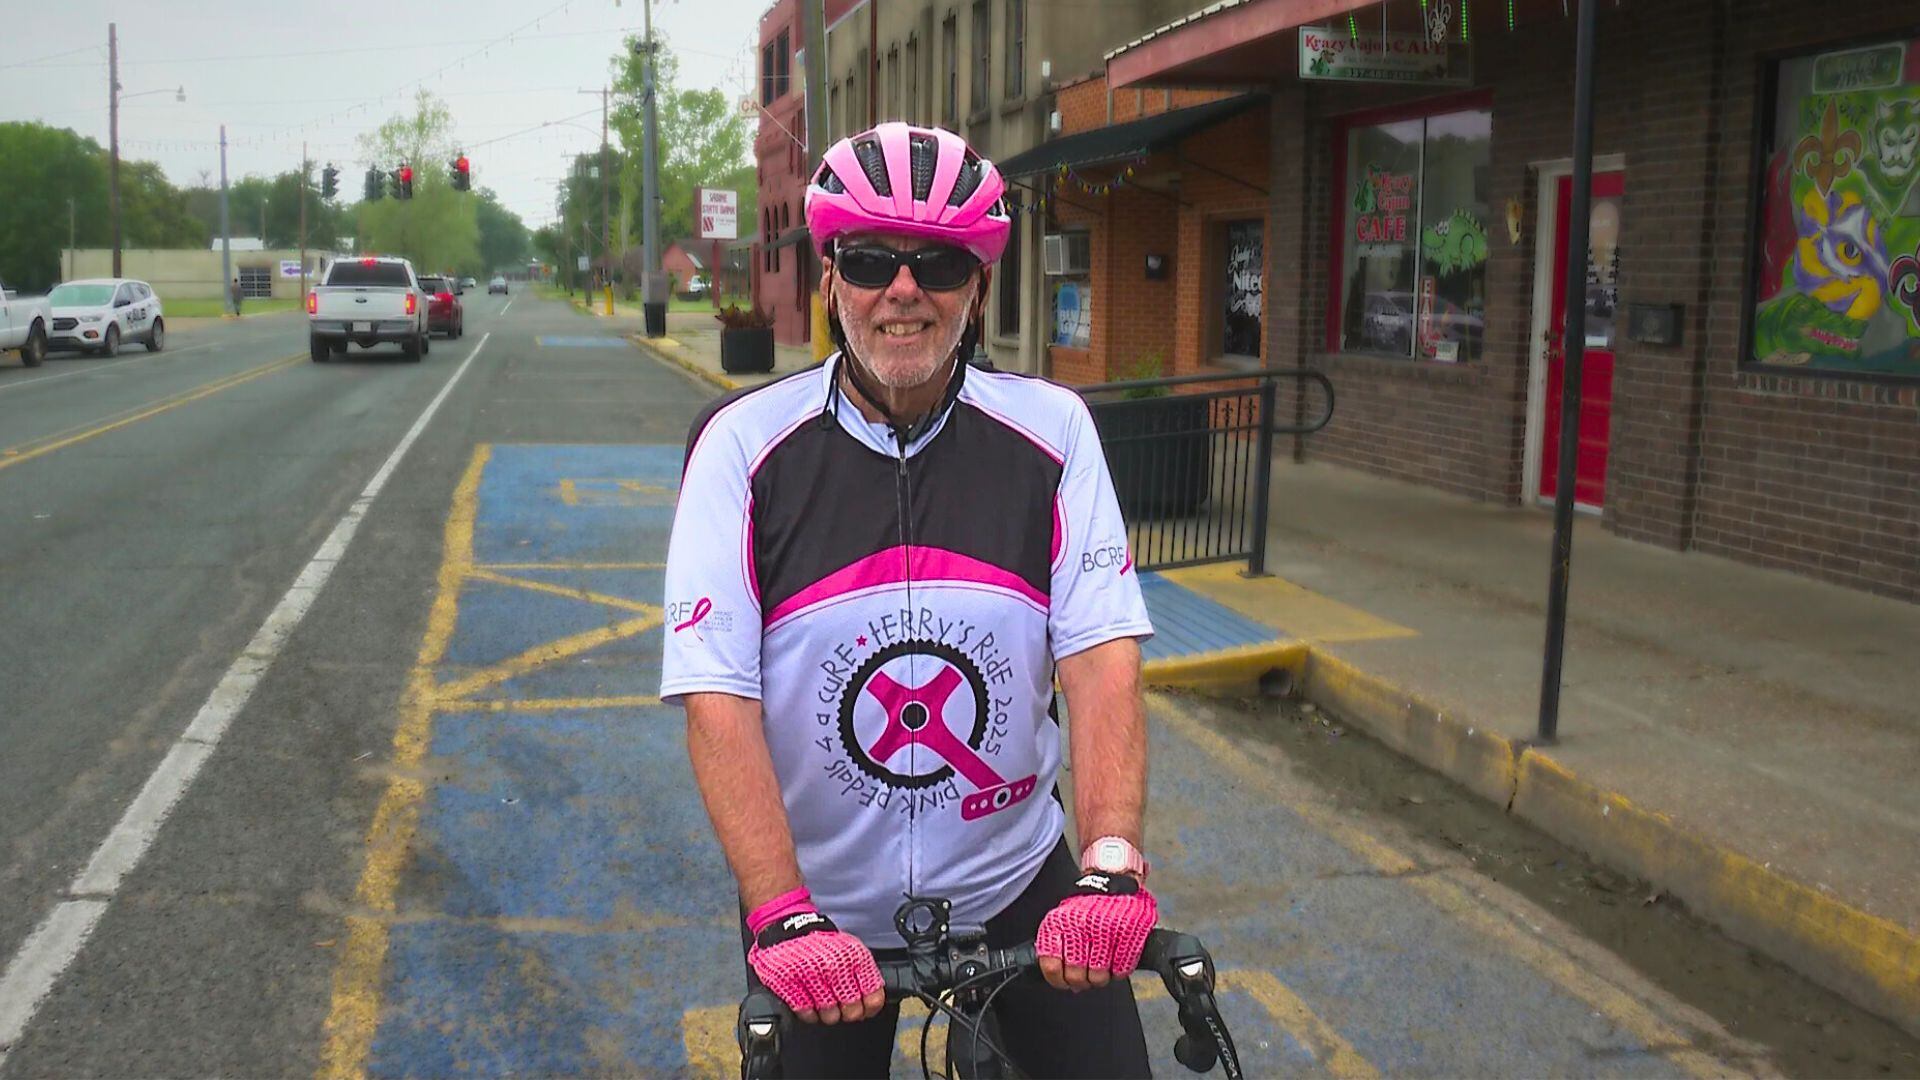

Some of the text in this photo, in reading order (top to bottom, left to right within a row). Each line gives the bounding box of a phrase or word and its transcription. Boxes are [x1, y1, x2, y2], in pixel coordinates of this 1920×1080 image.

[1304, 34, 1346, 53] Krazy
[1356, 215, 1407, 242] CAFE
[1082, 546, 1125, 573] BCRF
[664, 601, 692, 625] RF
[984, 696, 1013, 756] 2025
[815, 735, 833, 753] 4
